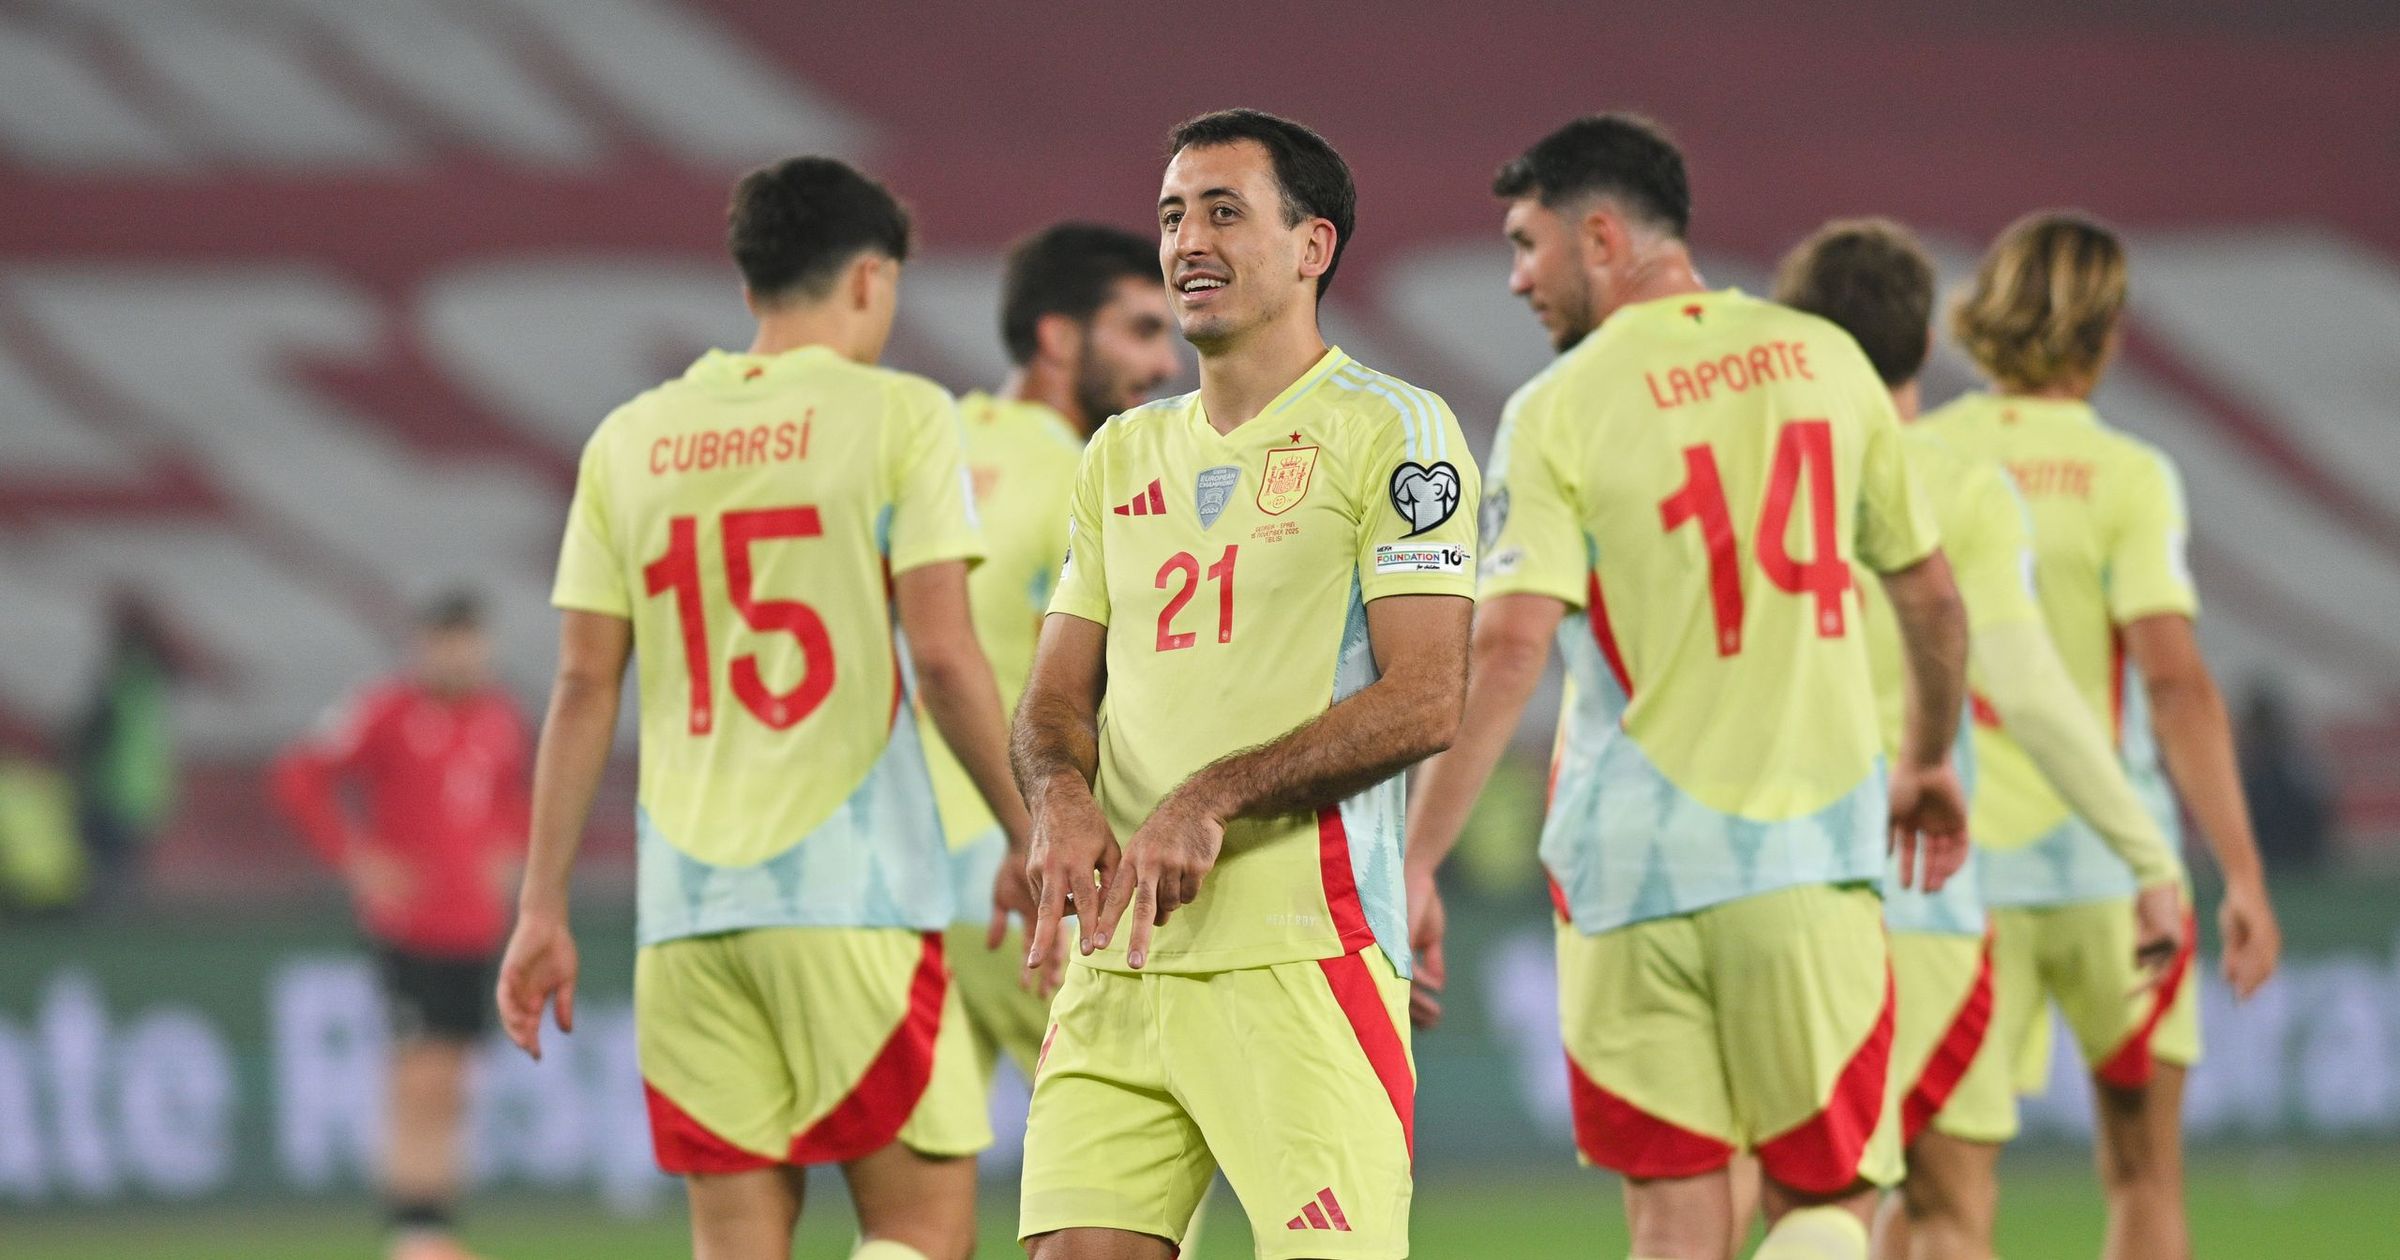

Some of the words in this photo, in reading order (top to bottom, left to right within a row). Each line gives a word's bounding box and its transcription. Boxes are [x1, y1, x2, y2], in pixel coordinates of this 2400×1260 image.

[1645, 342, 1814, 409] LAPORTE
[649, 407, 815, 476] CUBARSÍ
[1377, 553, 1440, 564] FOUNDATION
[1659, 418, 1851, 657] 14
[643, 505, 836, 736] 15
[1154, 544, 1239, 652] 21
